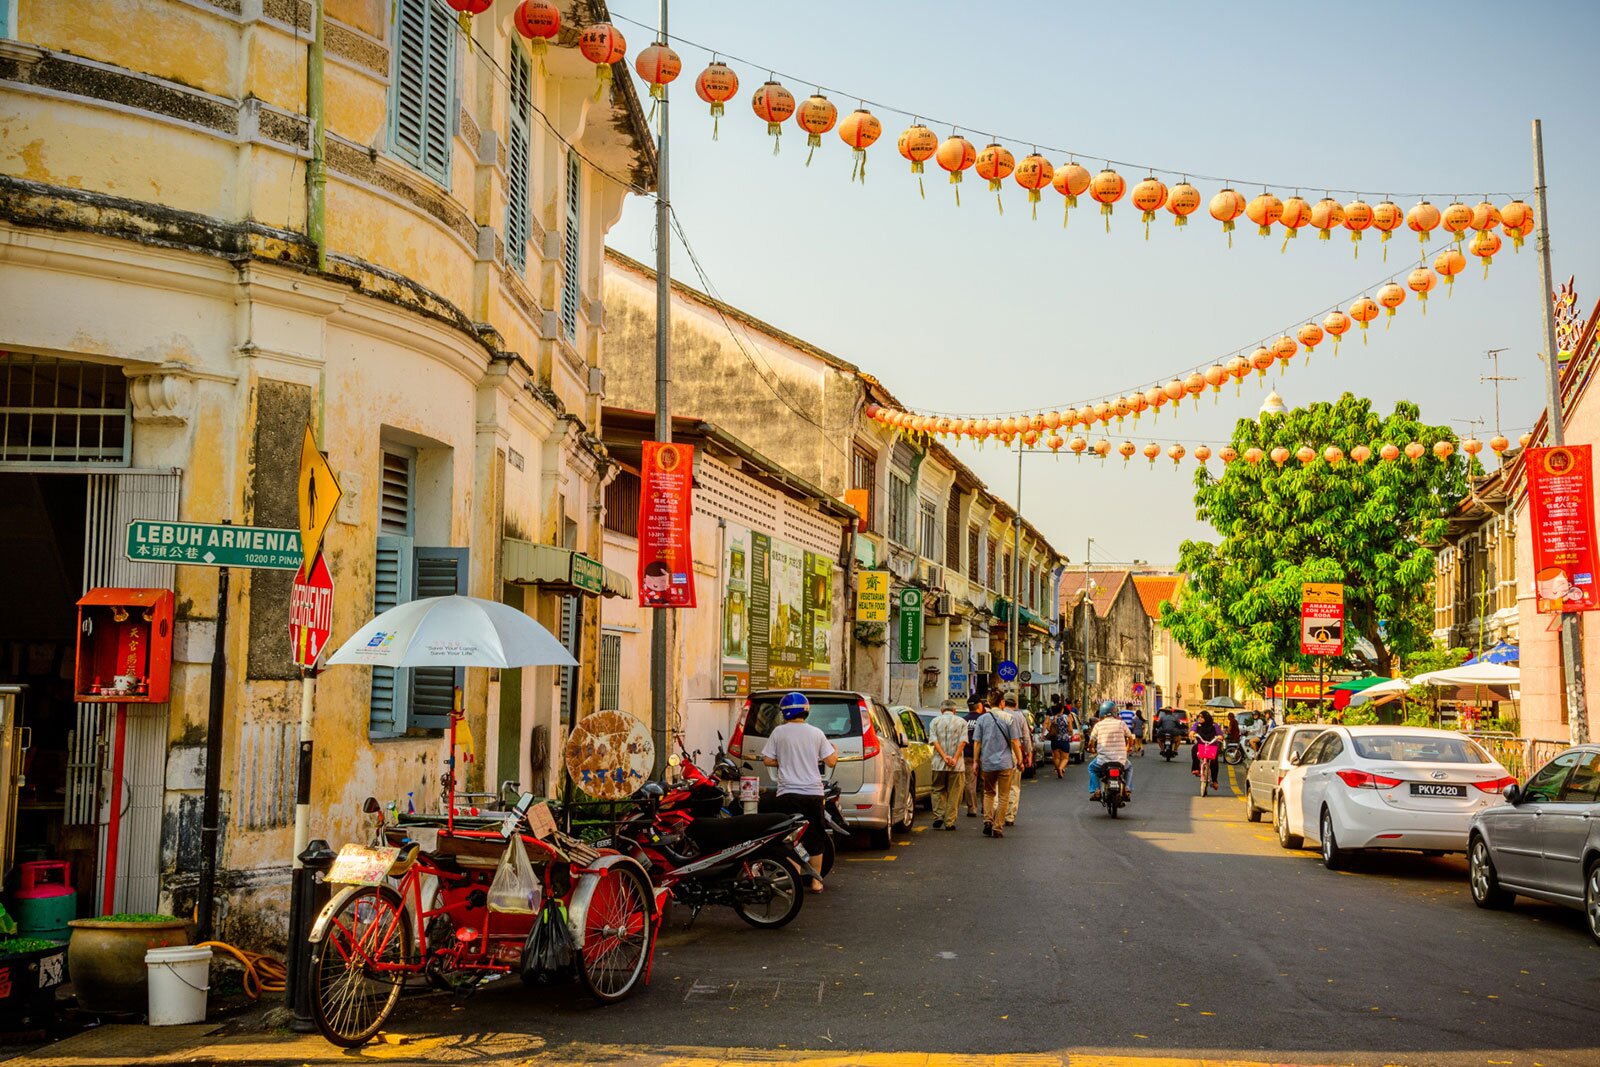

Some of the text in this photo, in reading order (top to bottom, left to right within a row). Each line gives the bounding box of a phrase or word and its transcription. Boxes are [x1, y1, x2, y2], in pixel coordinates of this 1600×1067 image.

[136, 524, 303, 553] LEBUH ARMENIA
[136, 544, 199, 559] 本頭公巷
[245, 554, 268, 563] 10200
[270, 555, 277, 564] P.
[860, 592, 885, 601] VEGETARIAN
[291, 584, 331, 630] BERHENTI
[858, 601, 885, 610] HEALTH FOOD
[866, 611, 877, 619] CAFE
